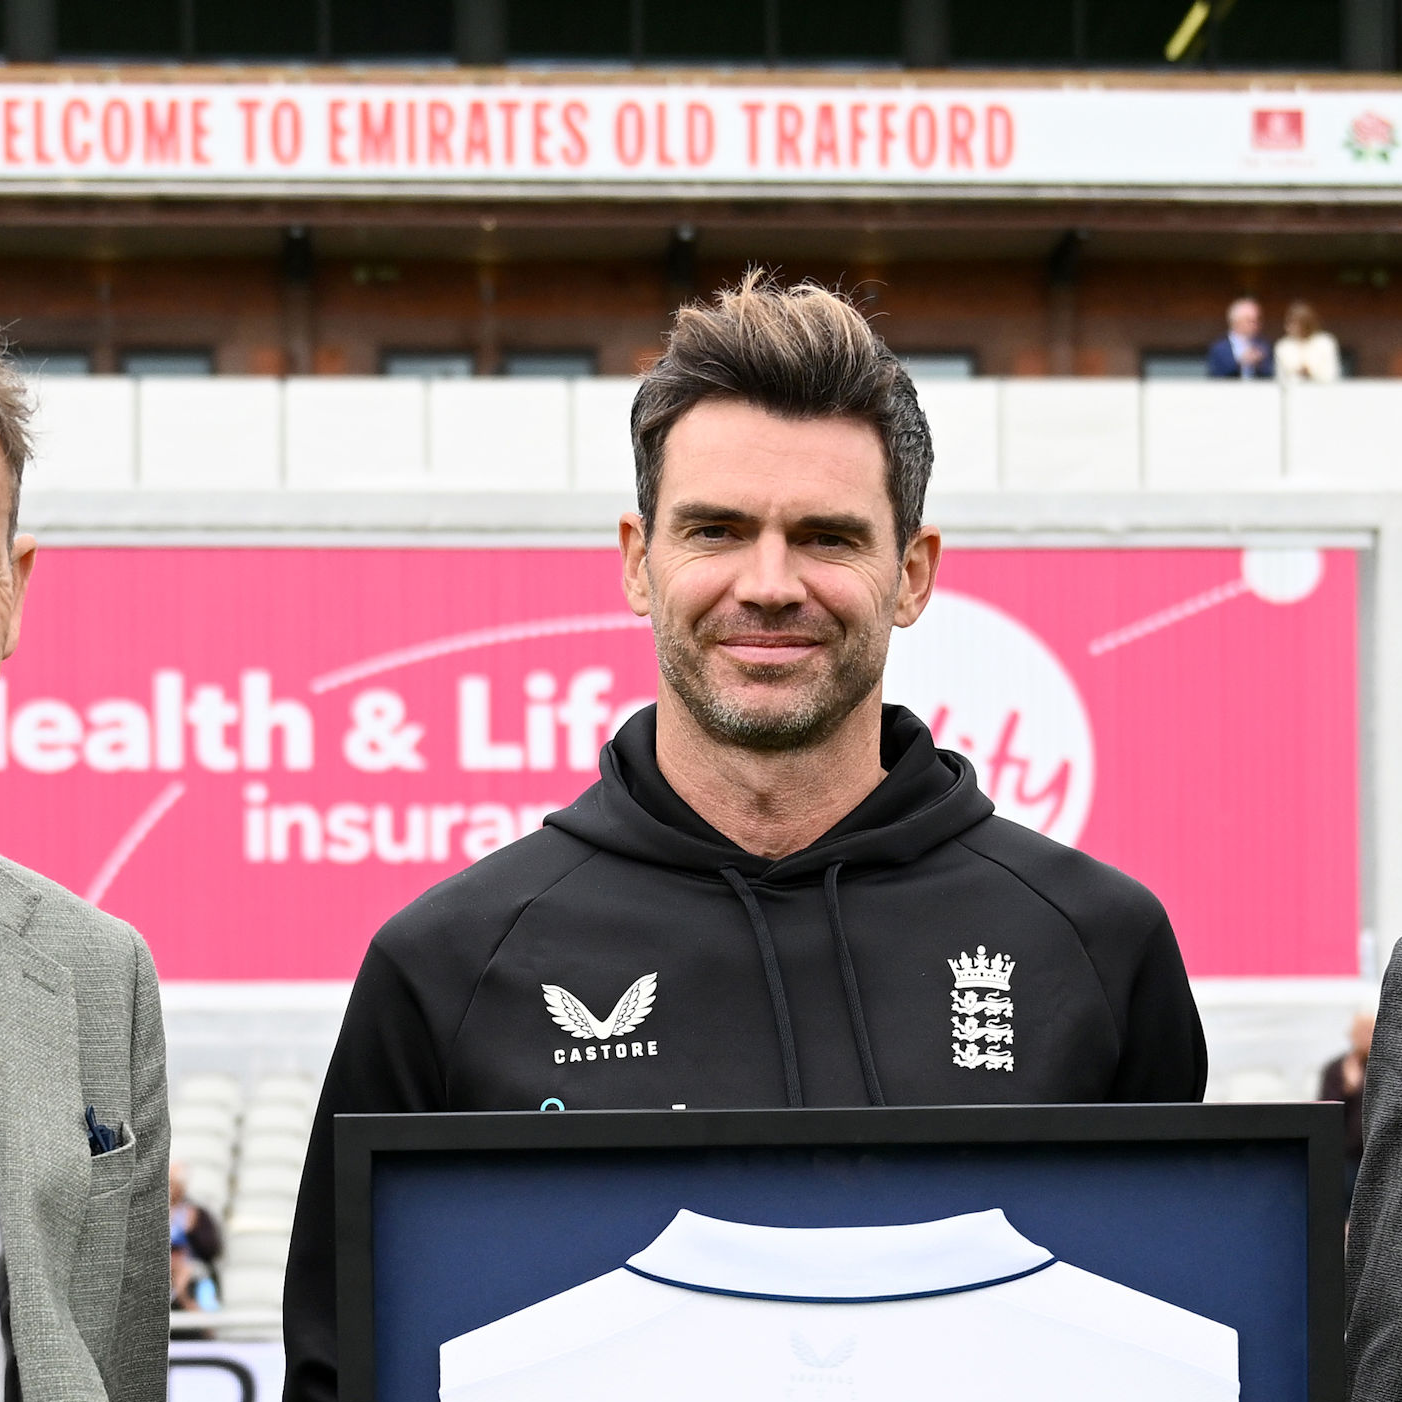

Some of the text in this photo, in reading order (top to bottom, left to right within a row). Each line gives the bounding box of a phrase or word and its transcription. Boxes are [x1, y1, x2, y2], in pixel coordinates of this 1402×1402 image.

[237, 98, 304, 167] TO
[328, 99, 591, 168] EMIRATES
[613, 100, 717, 168] OLD
[739, 101, 1015, 170] TRAFFORD
[342, 687, 425, 773] &
[458, 666, 656, 772] Lif
[554, 1040, 658, 1065] CASTORE
